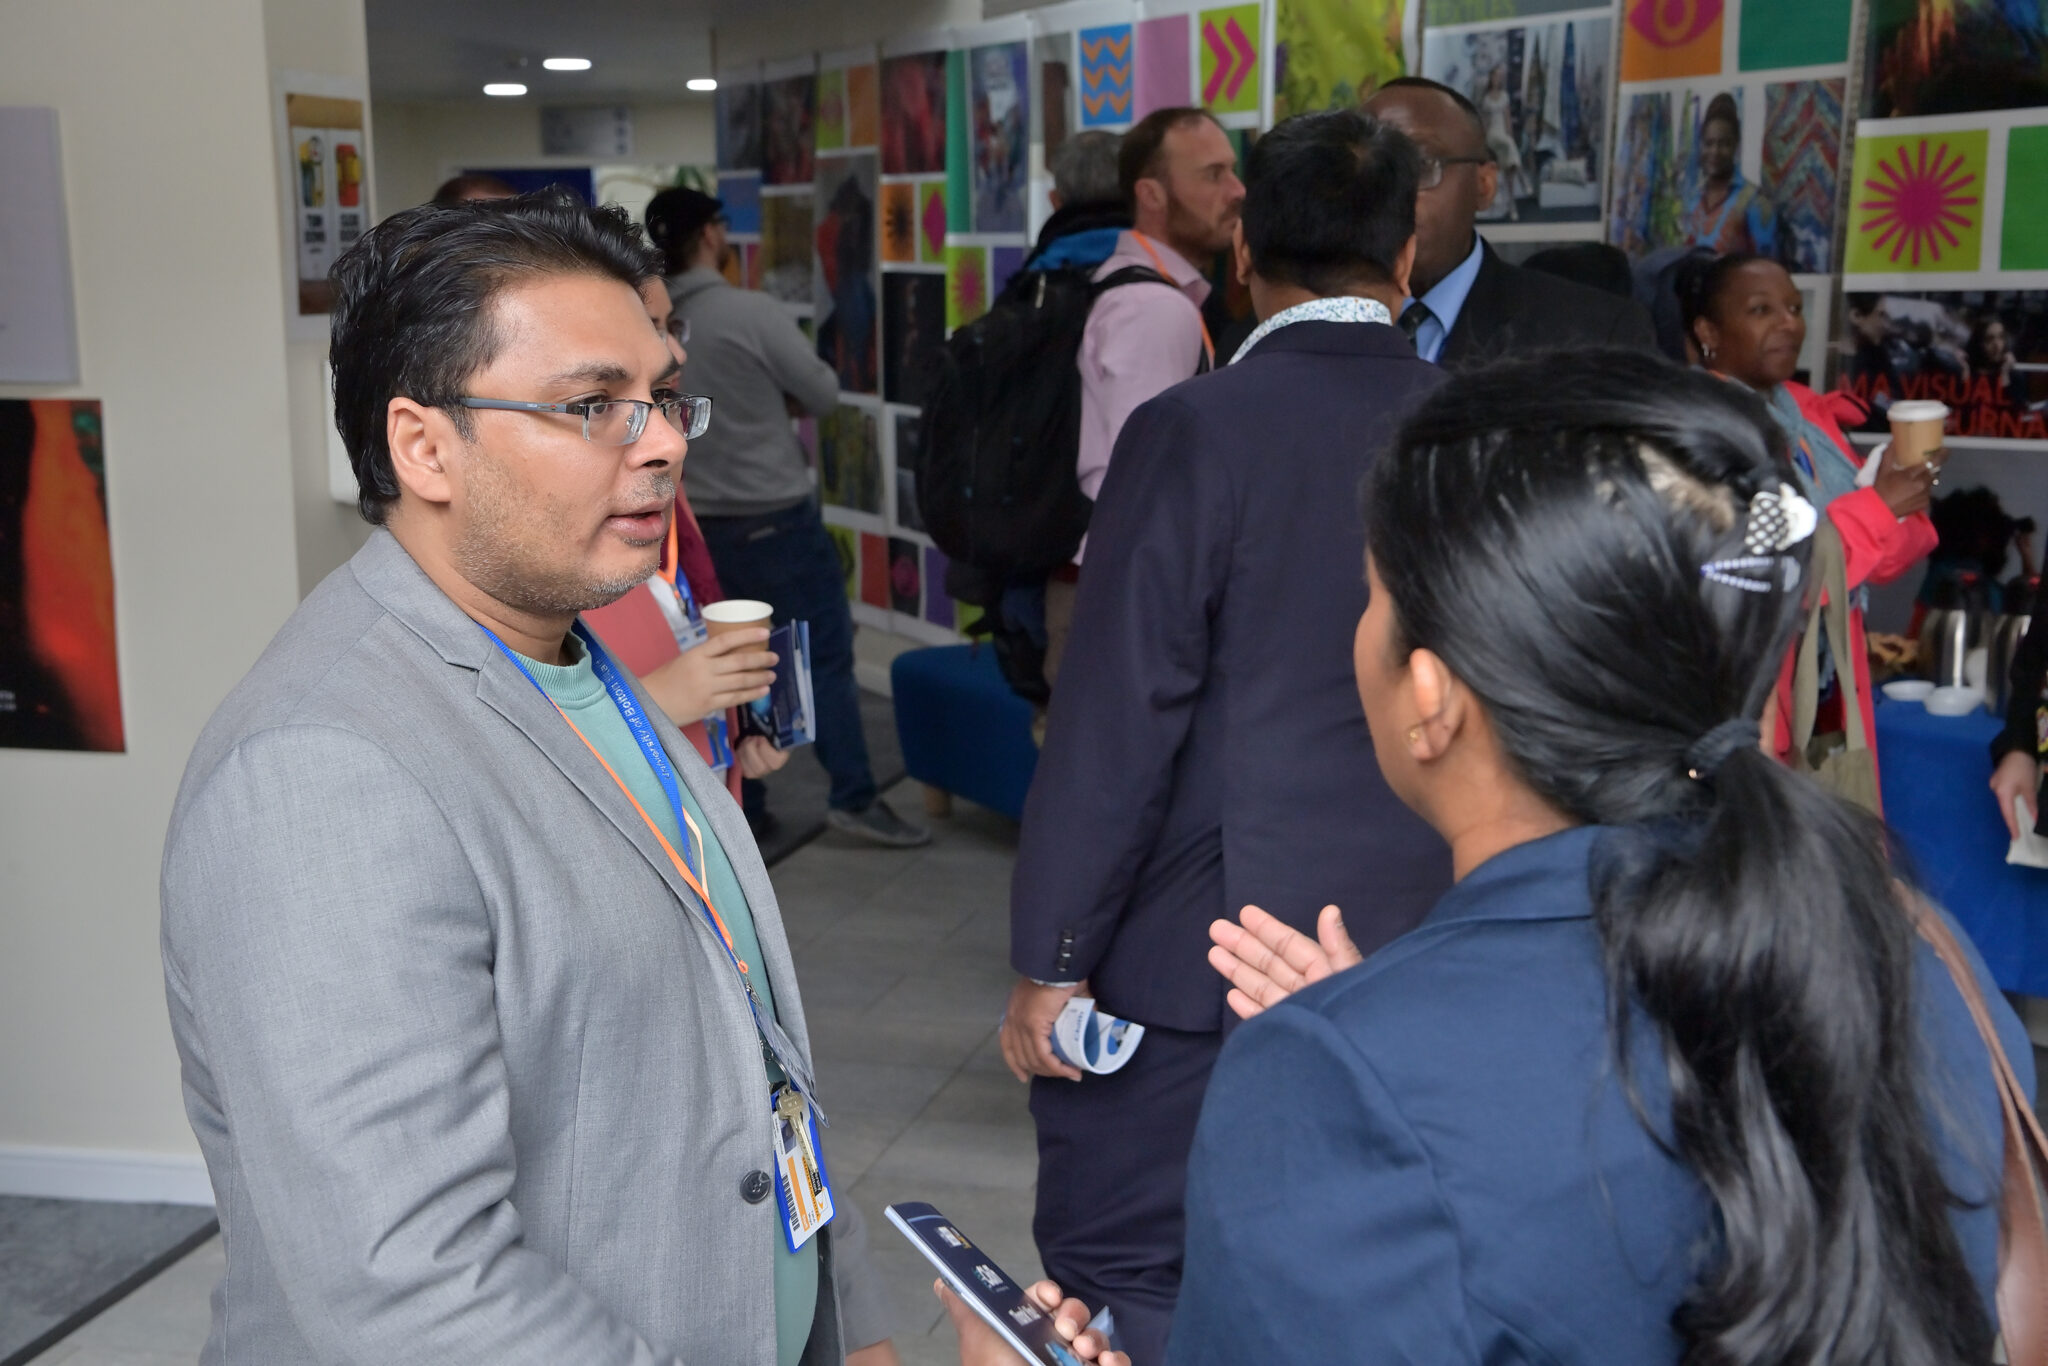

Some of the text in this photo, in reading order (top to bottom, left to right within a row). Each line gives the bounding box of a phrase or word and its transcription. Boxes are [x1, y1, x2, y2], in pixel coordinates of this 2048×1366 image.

[1838, 372, 2011, 405] MA VISUAL
[610, 681, 671, 780] University of Bolton
